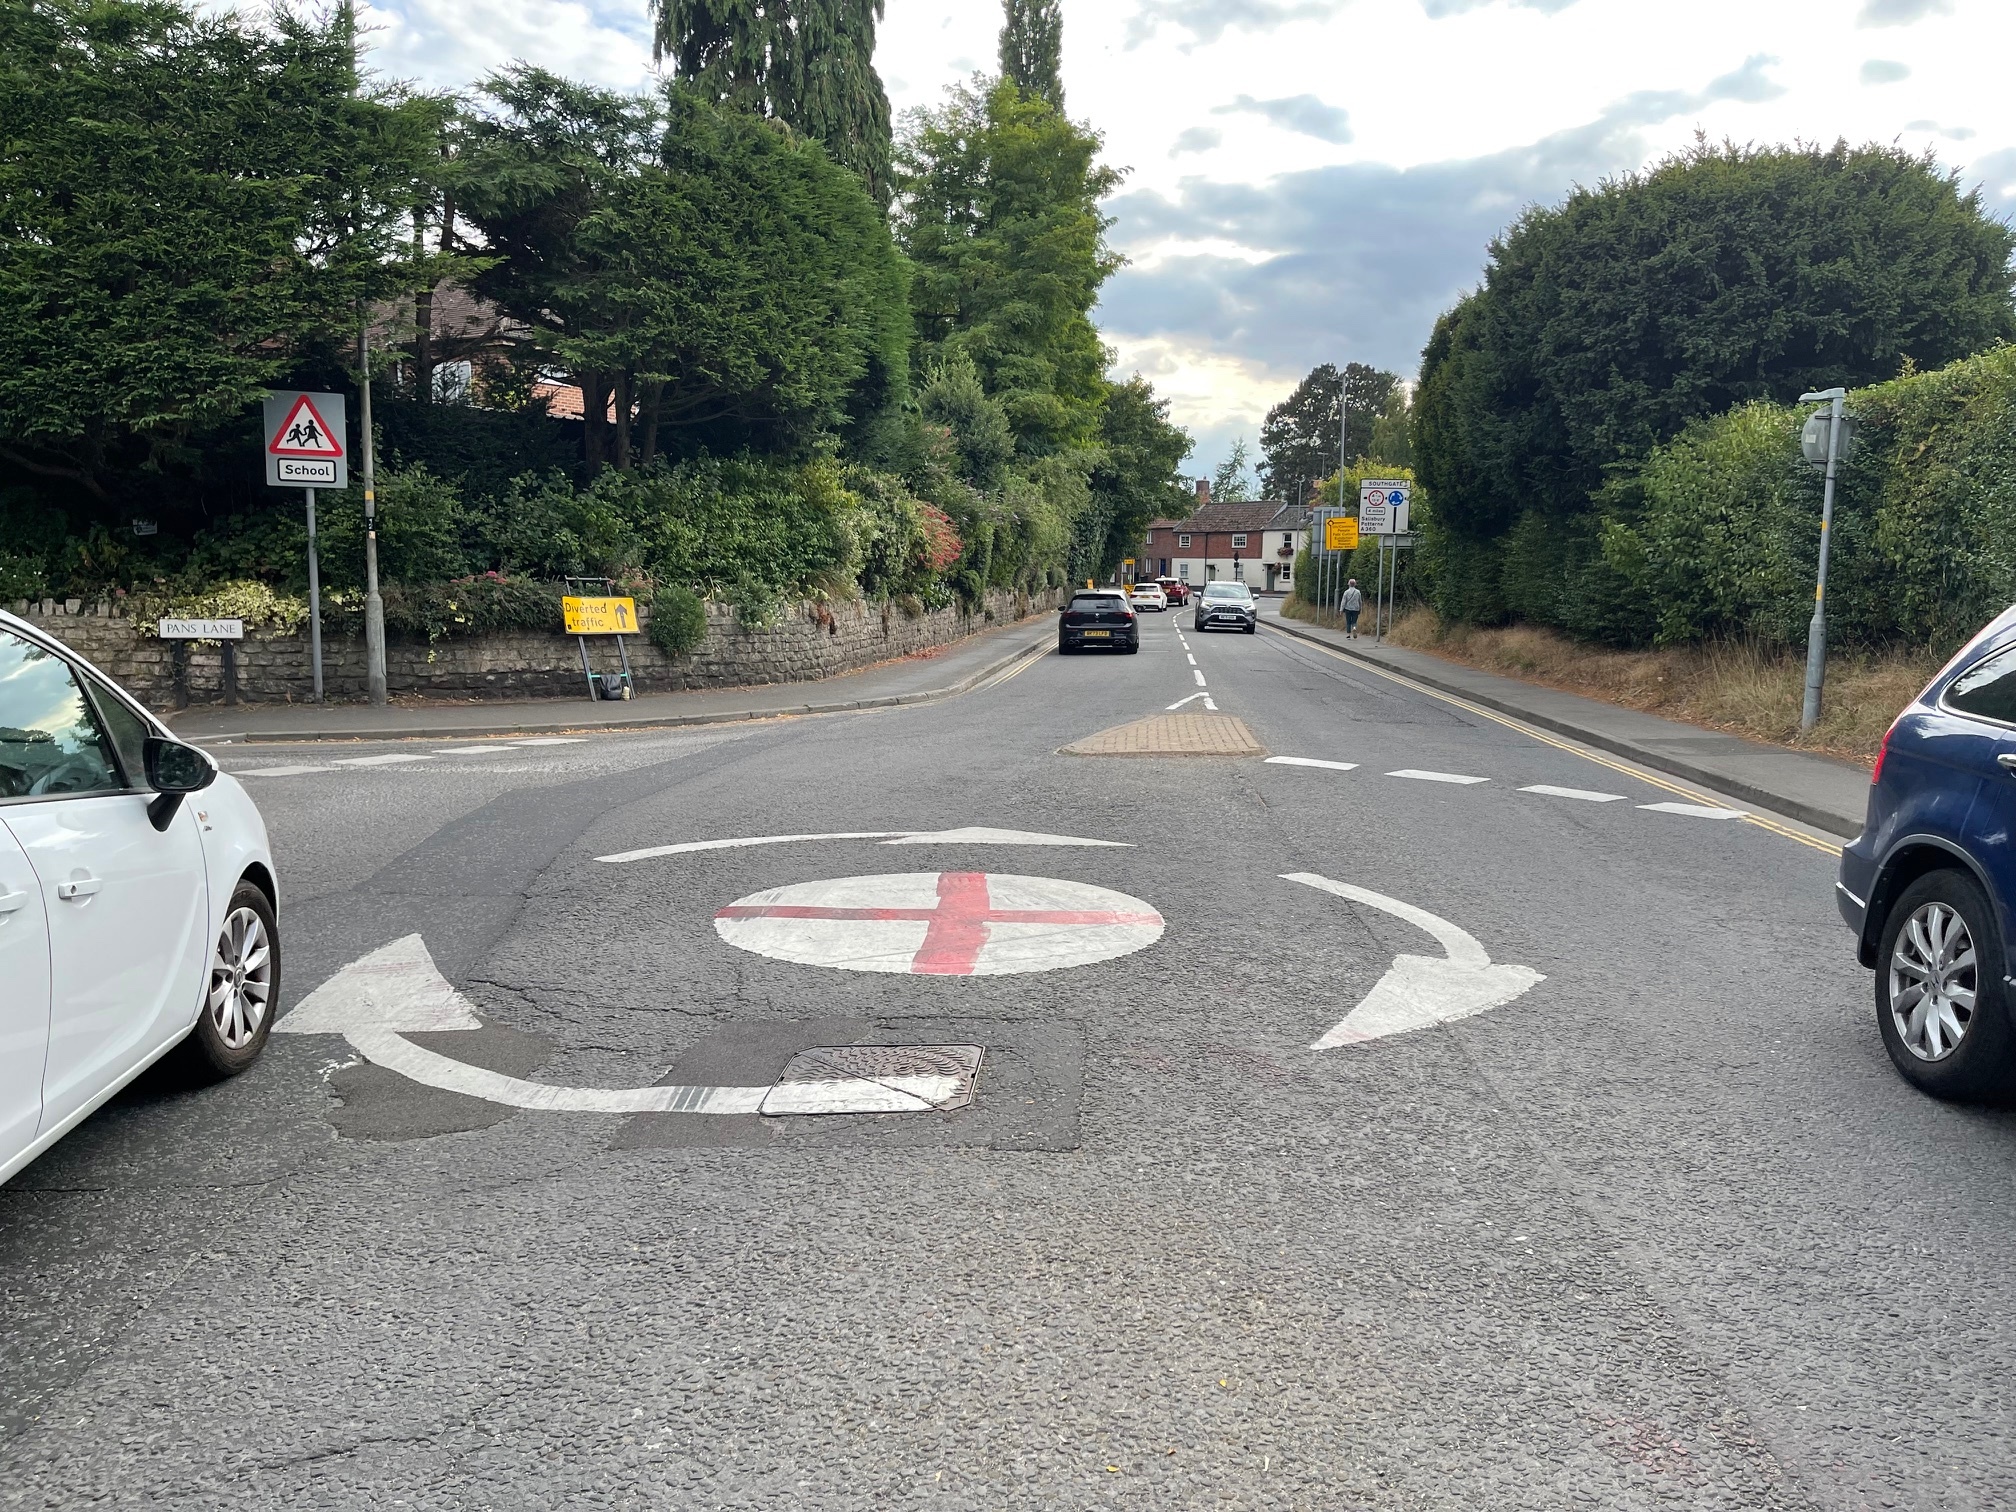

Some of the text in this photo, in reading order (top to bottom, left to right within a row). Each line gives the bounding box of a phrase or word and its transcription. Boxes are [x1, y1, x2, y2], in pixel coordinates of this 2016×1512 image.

[285, 464, 330, 476] School
[565, 602, 607, 614] Diverted
[572, 616, 604, 627] traffic
[167, 623, 236, 634] PANS LANE
